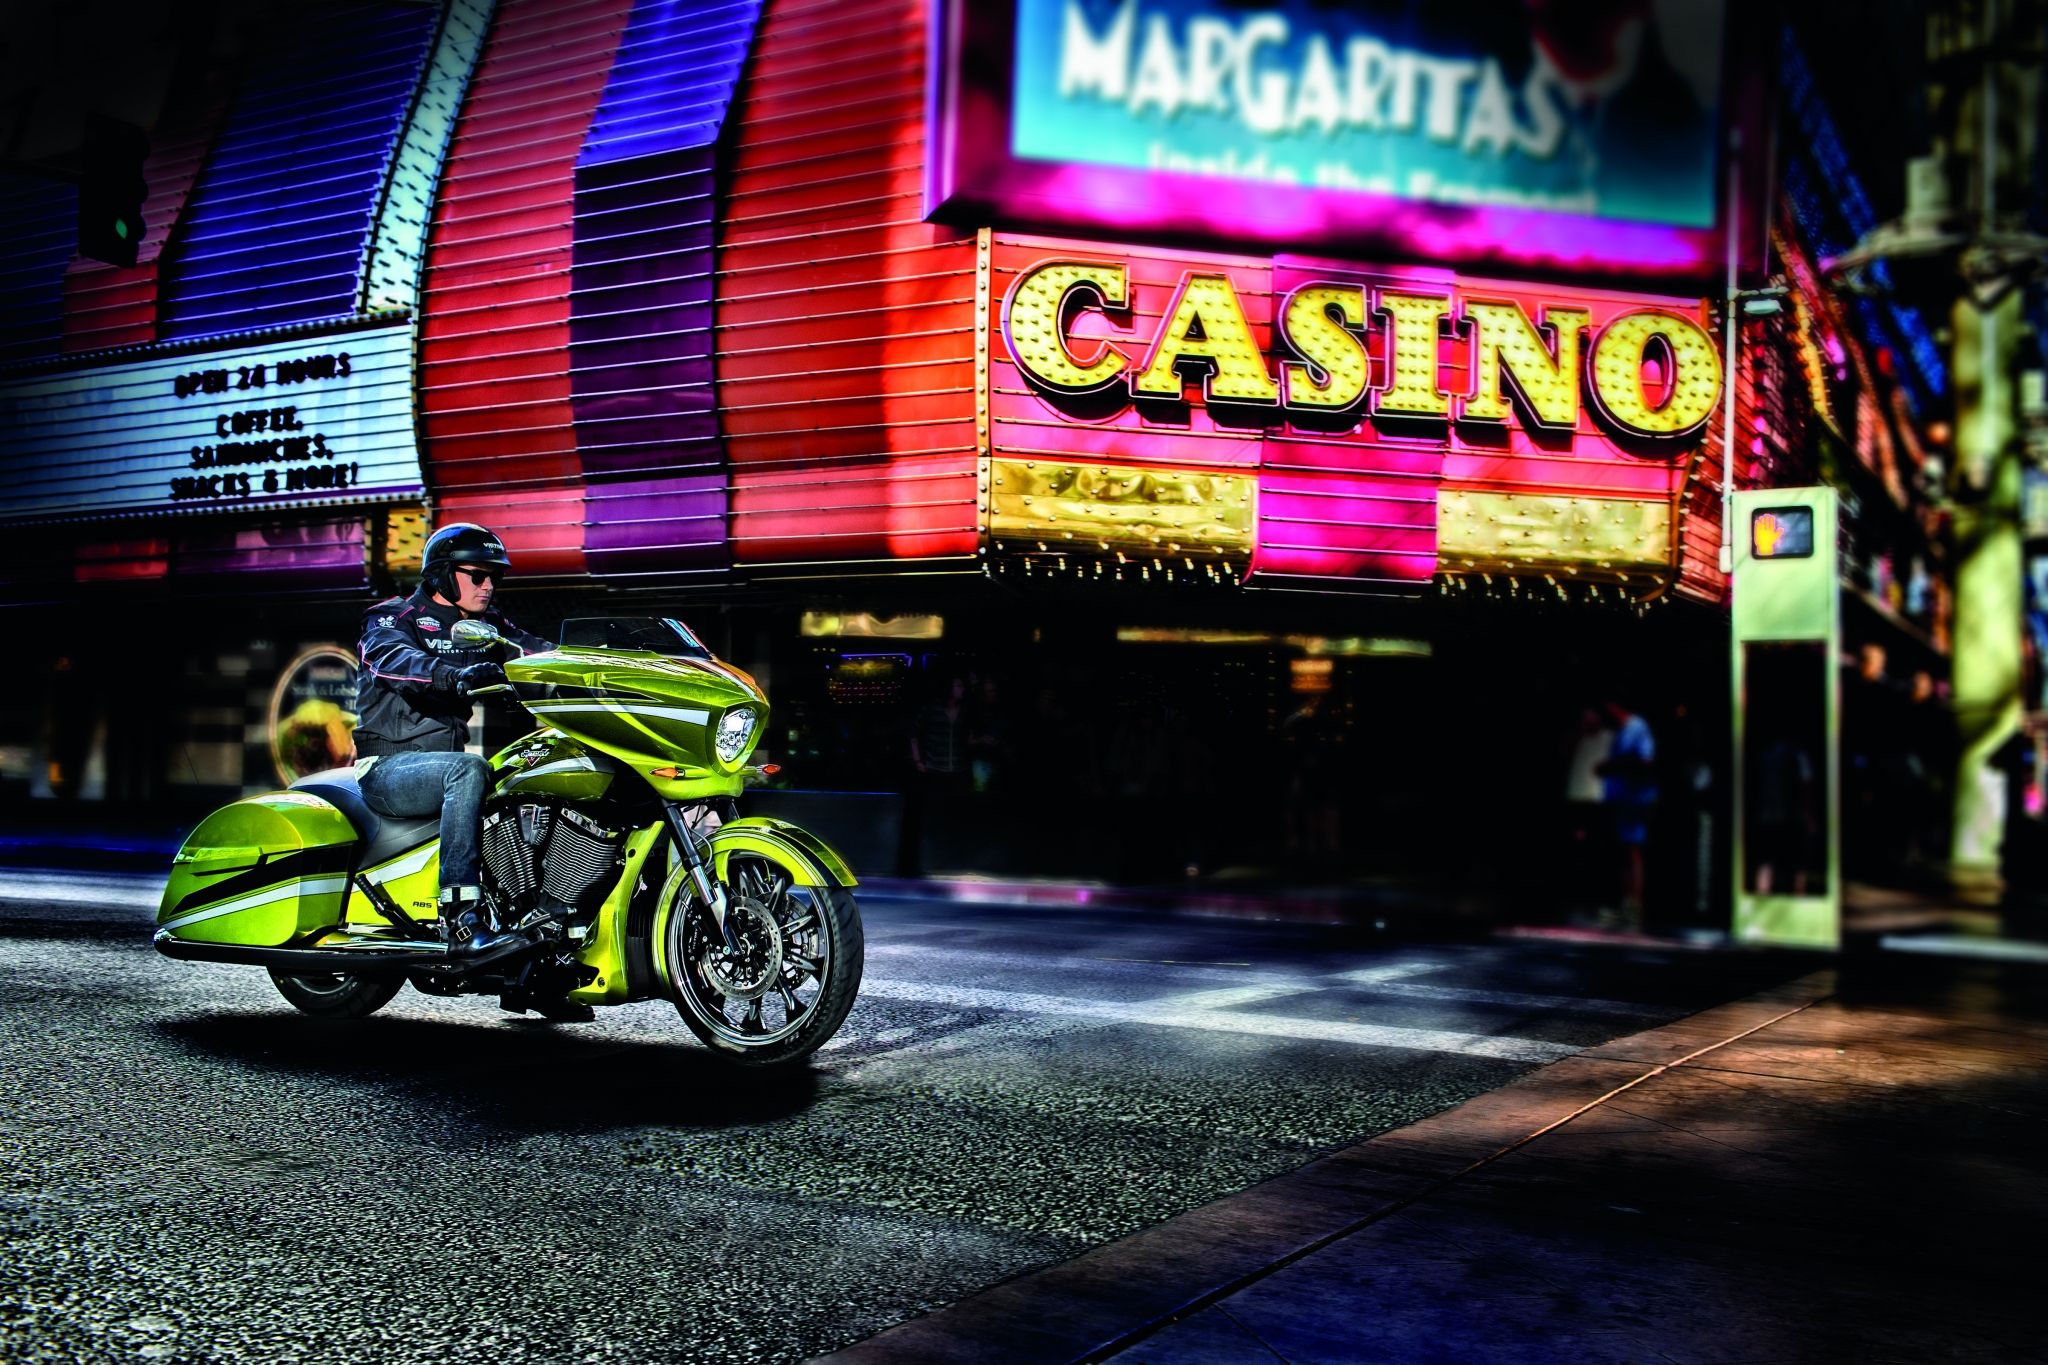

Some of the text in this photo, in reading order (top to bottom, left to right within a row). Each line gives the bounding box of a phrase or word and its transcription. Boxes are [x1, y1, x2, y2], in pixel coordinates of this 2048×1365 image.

[1060, 0, 1563, 157] MARGARITAS
[174, 352, 350, 399] OPEN 24 HOURS
[1003, 258, 1722, 438] CASINO
[169, 472, 250, 501] SNACKS
[286, 462, 358, 492] MORE!
